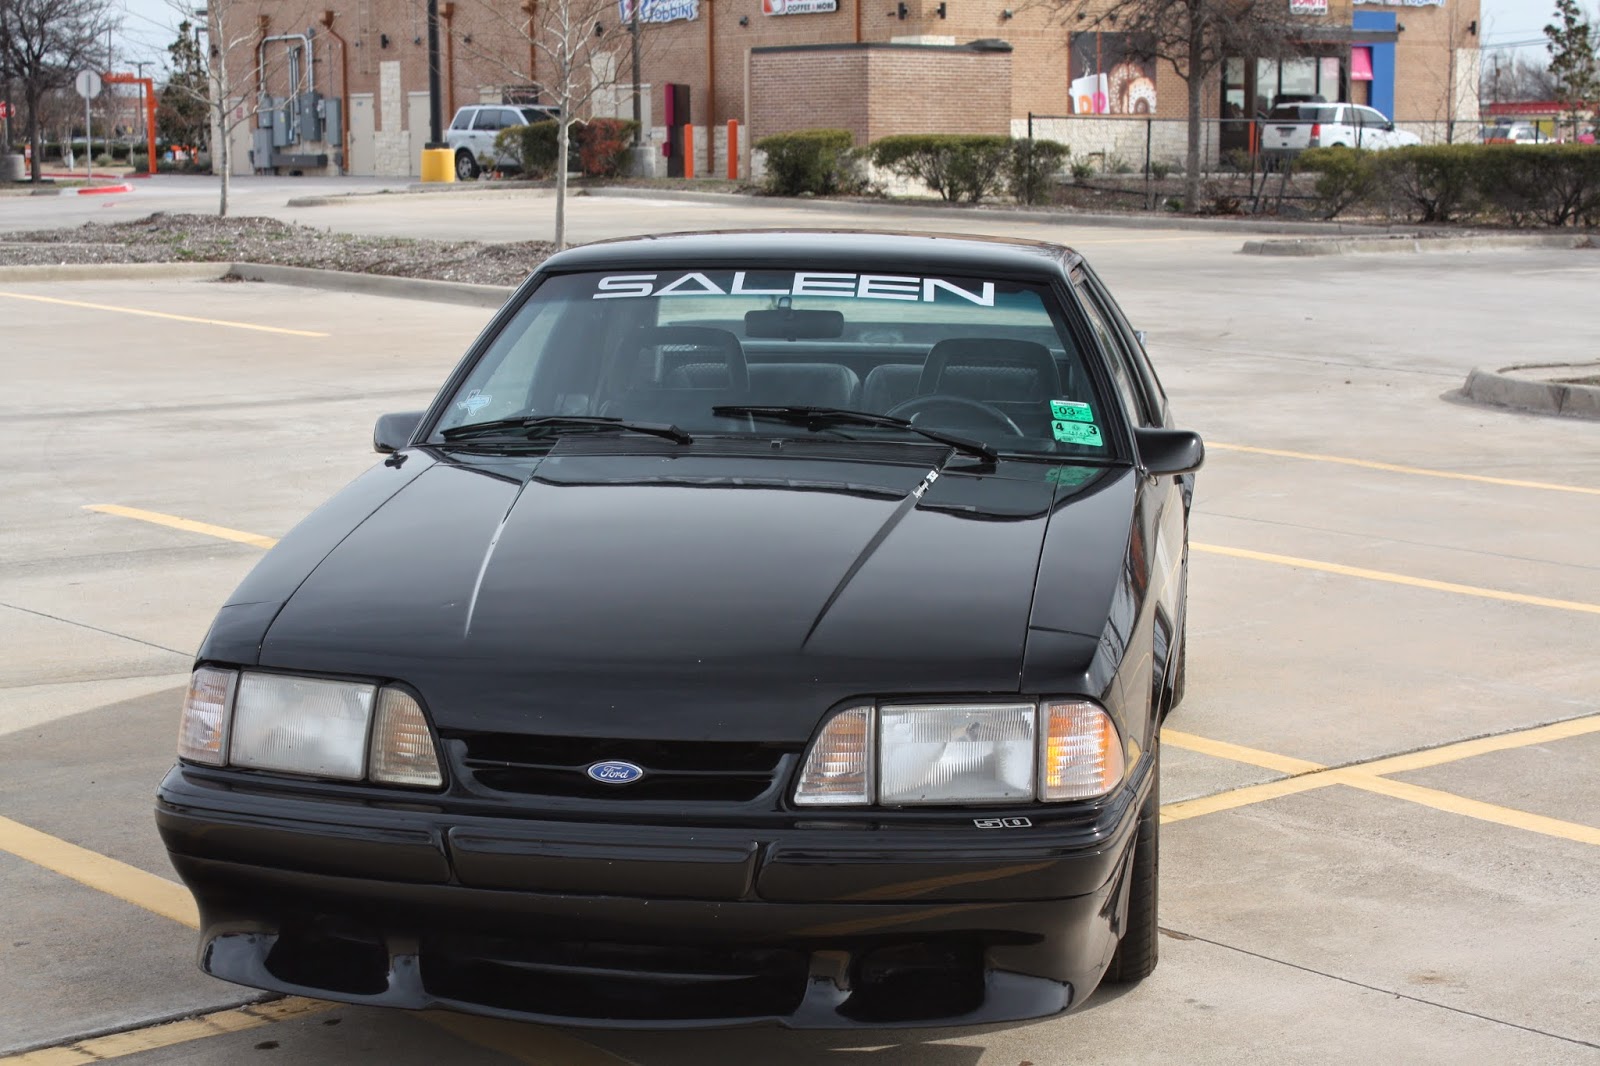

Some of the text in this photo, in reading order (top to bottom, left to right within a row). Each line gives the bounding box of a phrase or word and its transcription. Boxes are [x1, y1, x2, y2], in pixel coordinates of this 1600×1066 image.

[787, 4, 810, 12] COFFEE
[816, 2, 834, 10] MORE
[592, 271, 995, 307] SALEEN
[1059, 406, 1075, 416] 03
[1055, 422, 1064, 431] 4
[1089, 425, 1098, 435] 3
[600, 766, 630, 779] Ford
